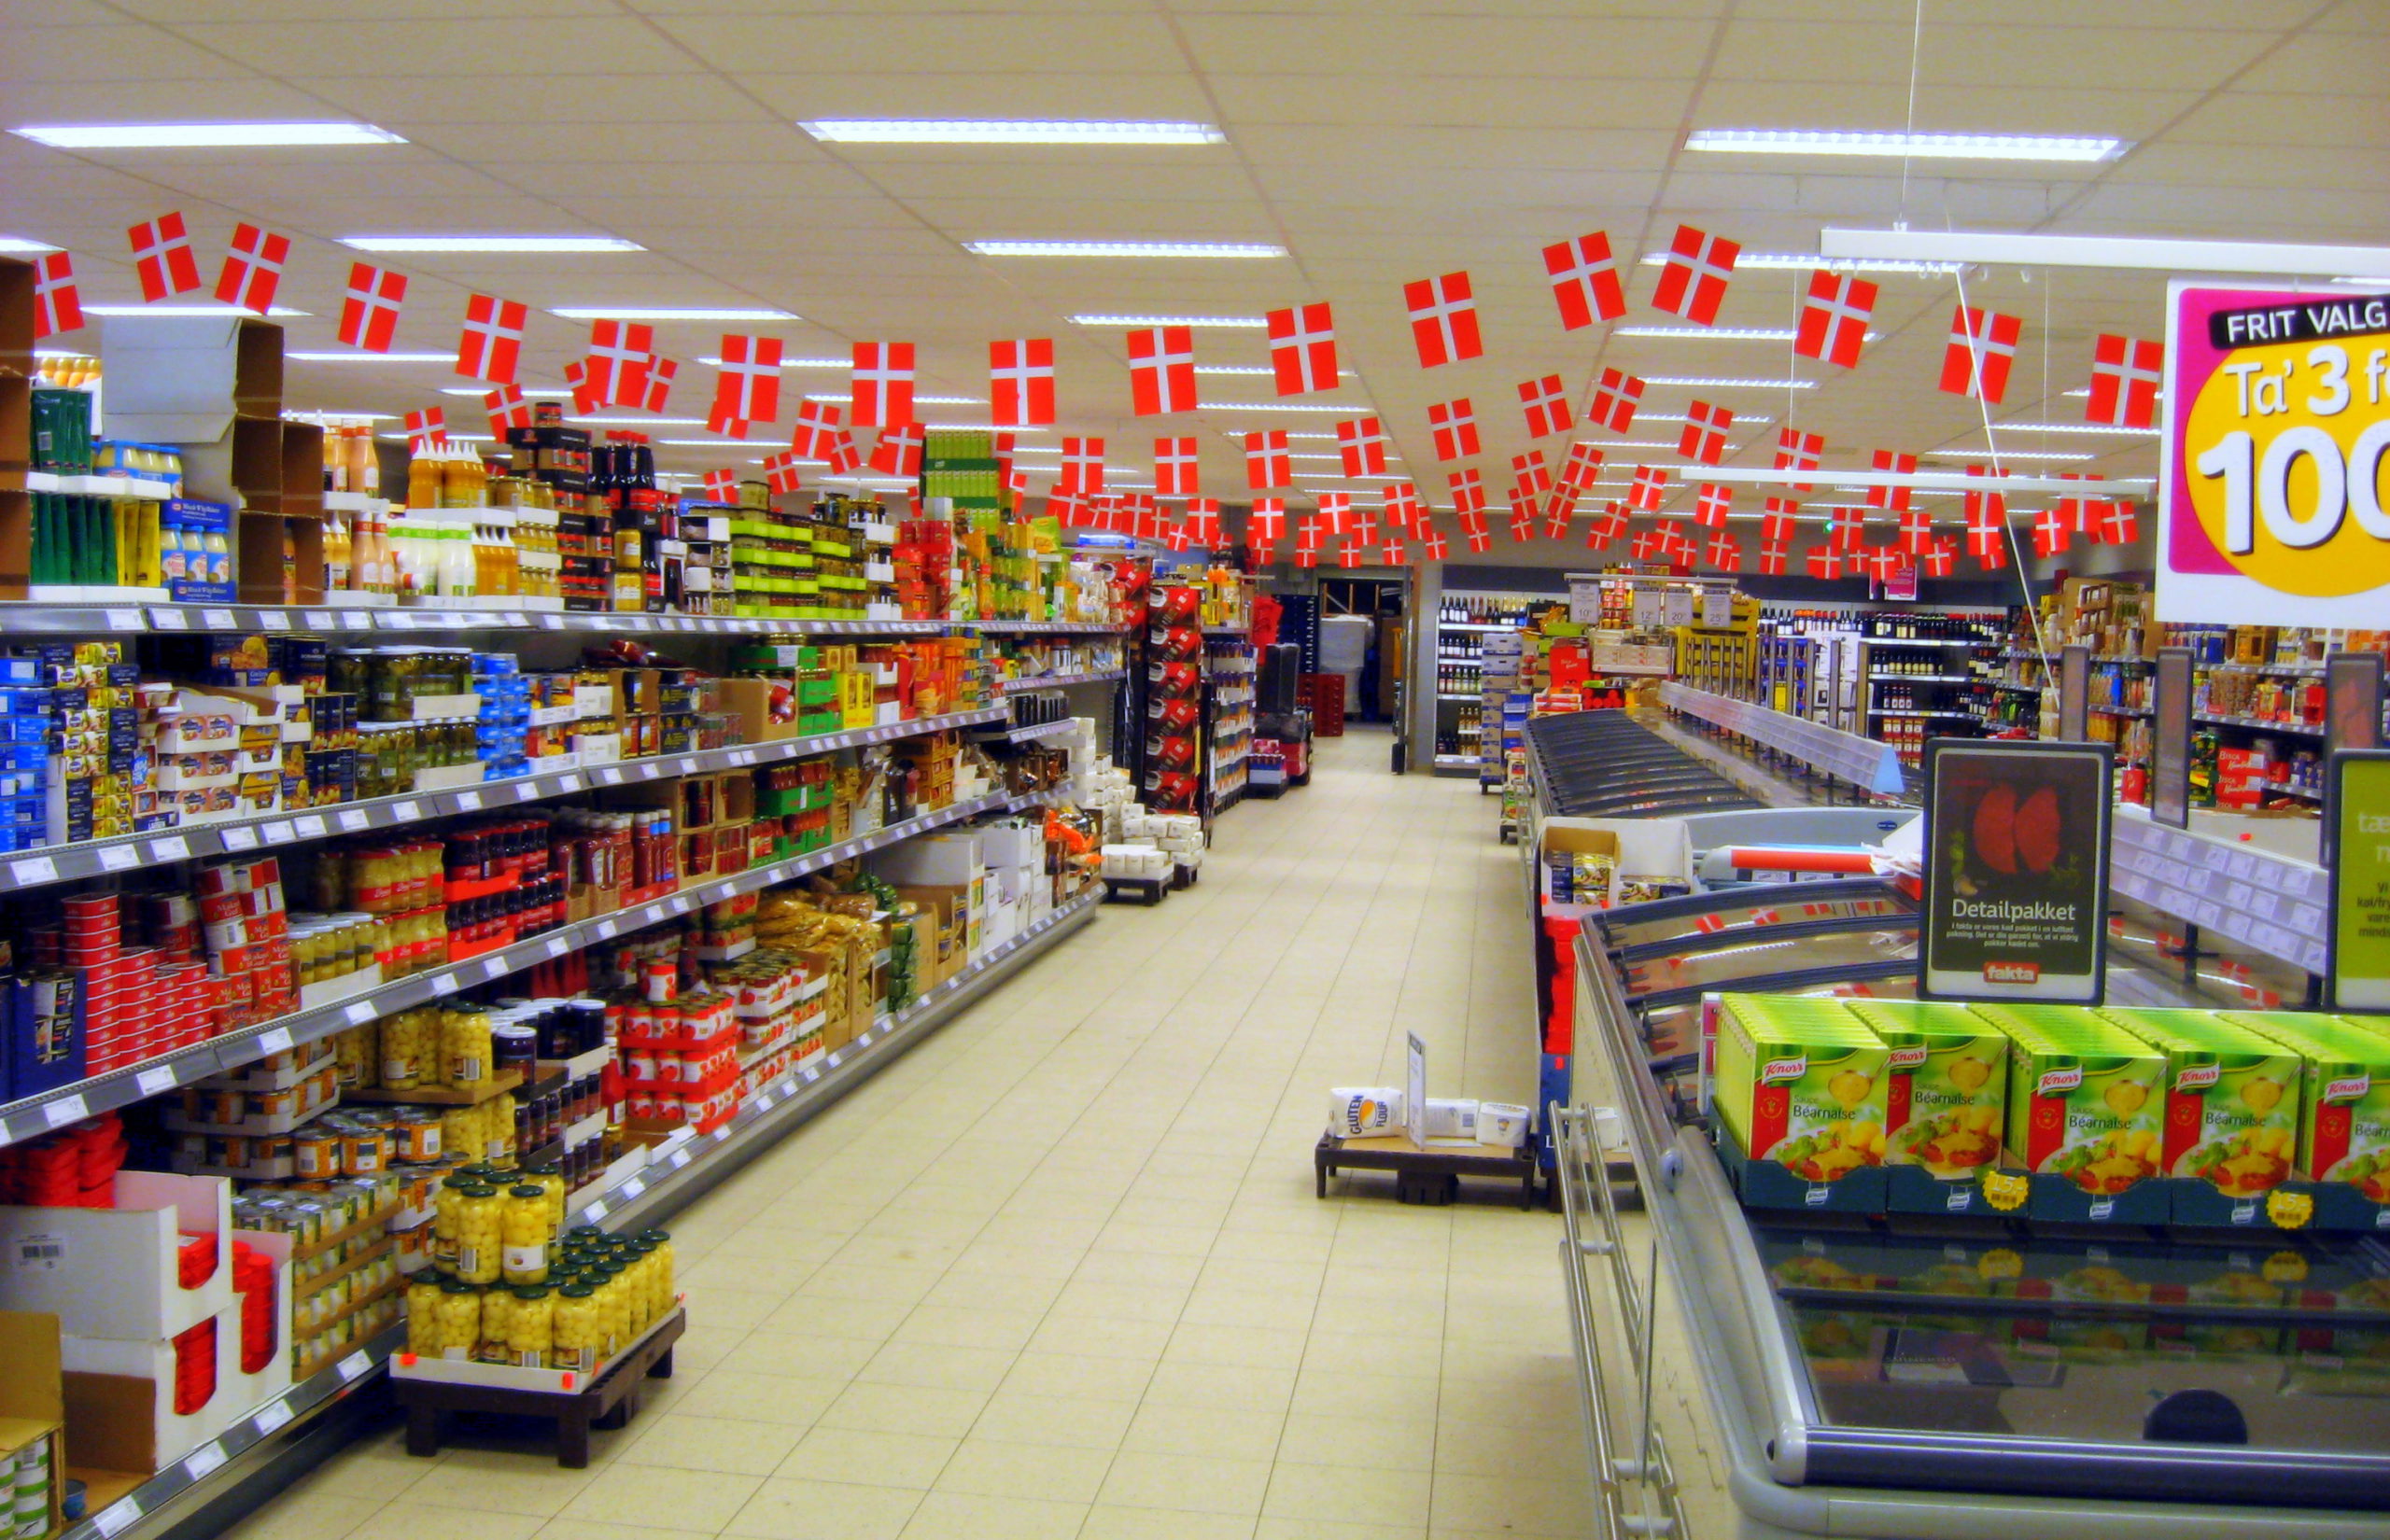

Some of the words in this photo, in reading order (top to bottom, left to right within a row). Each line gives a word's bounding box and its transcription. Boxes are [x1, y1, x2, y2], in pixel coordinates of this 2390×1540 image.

[2227, 310, 2296, 343] FRIT
[2306, 301, 2387, 334] VALG
[2222, 359, 2293, 417] Ta'
[2306, 344, 2351, 416] 3
[1952, 899, 2076, 922] Detailpakket
[1987, 965, 2034, 981] fakta
[1888, 1049, 1926, 1063] Knorr
[1764, 1061, 1804, 1076] Knorr
[2039, 1072, 2080, 1085] Knorr
[2178, 1069, 2219, 1084] Knorr
[2327, 1082, 2368, 1096] Knorr
[1915, 1091, 1975, 1106] Béarnaise
[1792, 1105, 1857, 1121] Béarnaise
[2205, 1112, 2267, 1127] Béarnaise
[2068, 1115, 2131, 1130] Béarnaise
